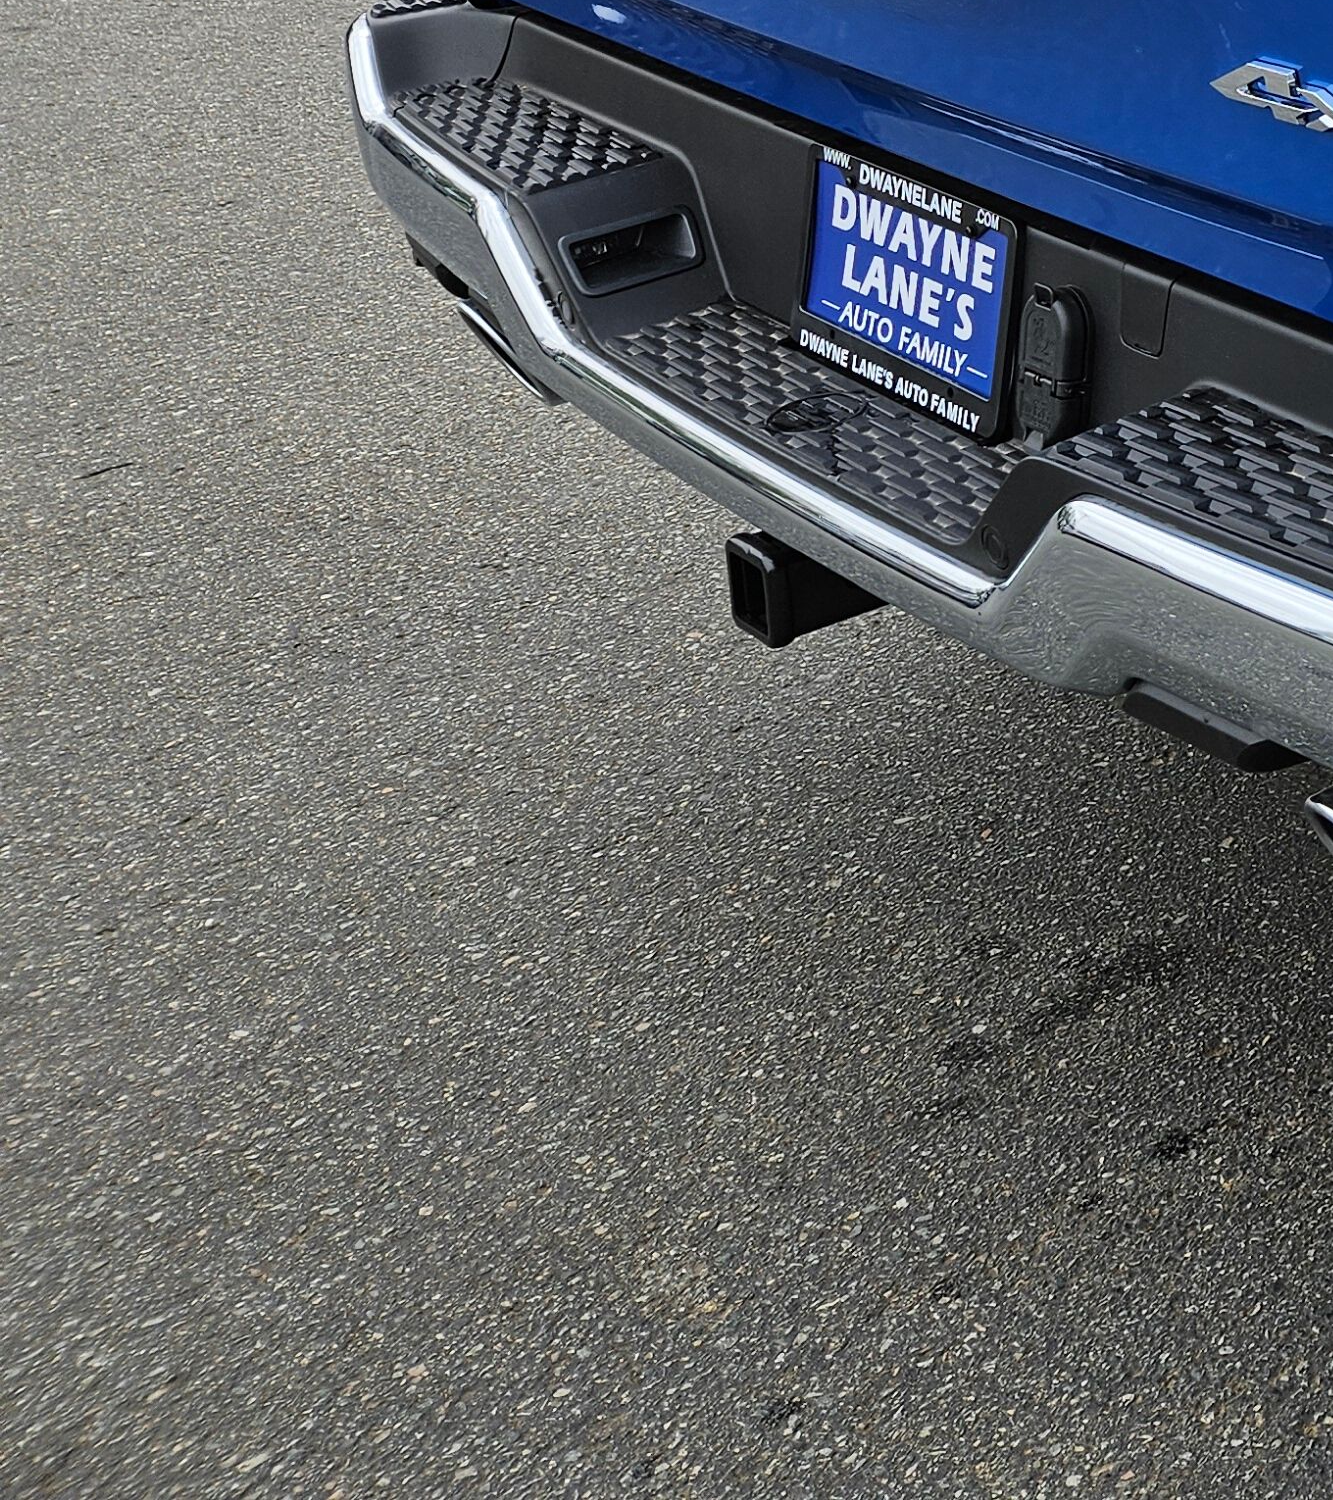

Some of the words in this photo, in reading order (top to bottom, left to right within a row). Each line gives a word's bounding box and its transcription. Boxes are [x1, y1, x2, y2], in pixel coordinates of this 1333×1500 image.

[831, 184, 996, 294] DWAYNE
[859, 164, 962, 224] DWAYNELANE
[975, 207, 999, 231] .COM
[837, 302, 893, 343] AUTO
[899, 327, 968, 377] FAMILY
[841, 244, 975, 341] LANE'S
[800, 329, 848, 367] DWAYNE
[851, 354, 893, 389] LANE'S
[895, 377, 928, 407] AUTO
[931, 397, 980, 433] FAMILY
